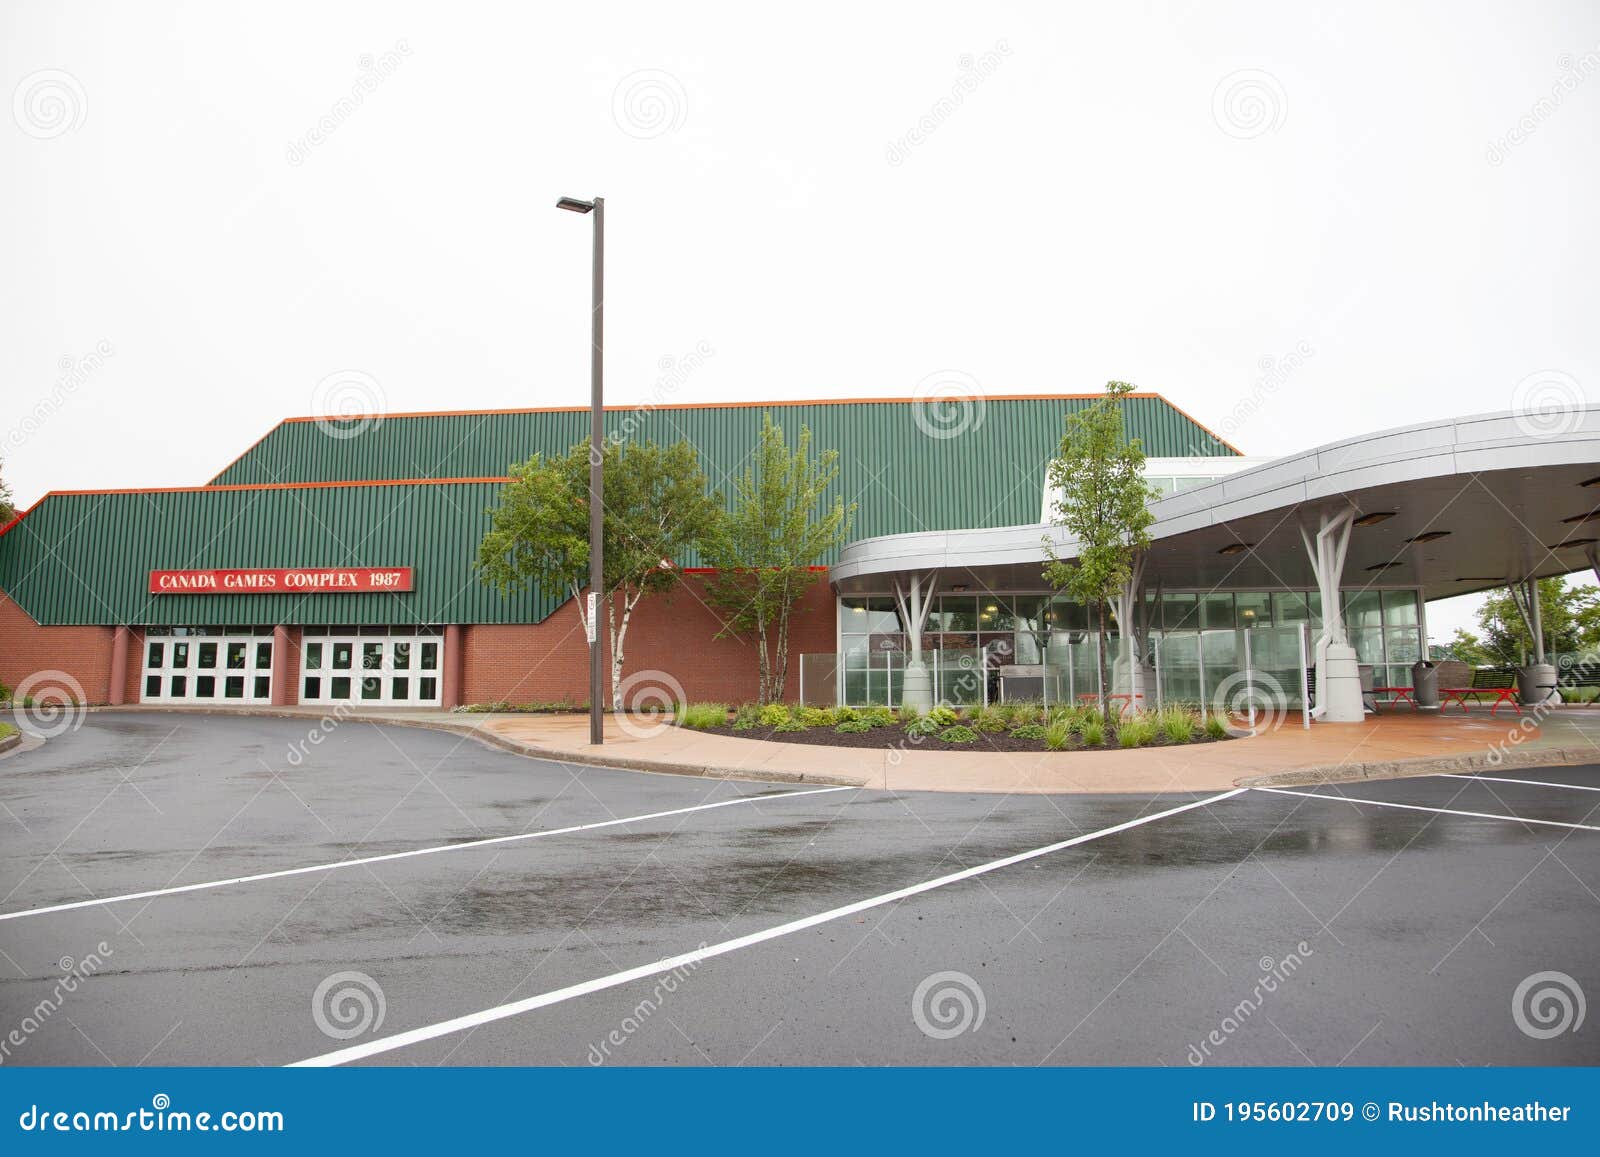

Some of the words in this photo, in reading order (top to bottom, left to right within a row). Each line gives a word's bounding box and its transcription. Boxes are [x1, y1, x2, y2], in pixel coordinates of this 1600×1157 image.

[160, 574, 216, 589] CANADA
[223, 573, 276, 588] GAMES
[284, 572, 358, 587] COMPLEX
[369, 572, 401, 587] 1987
